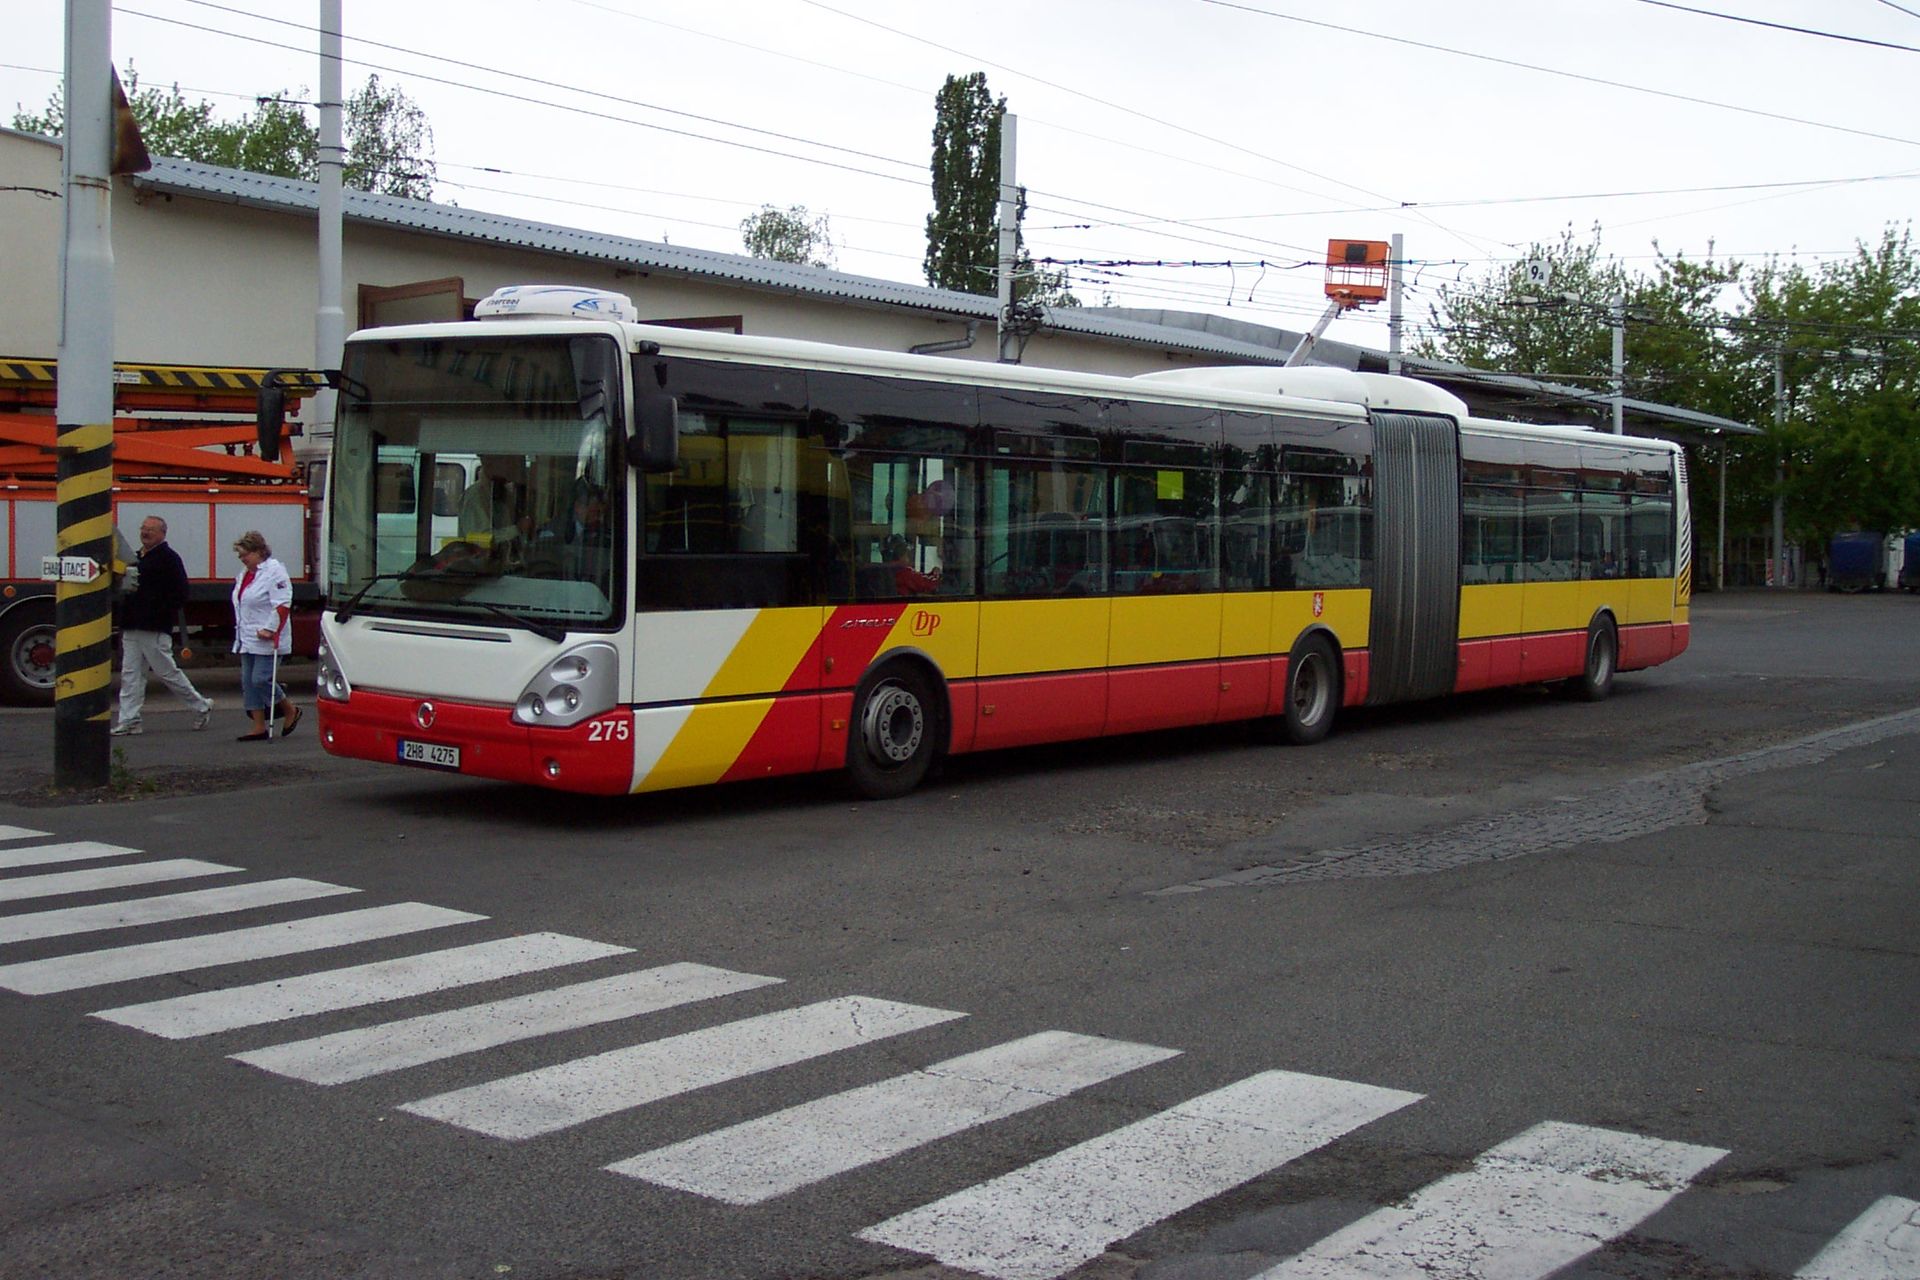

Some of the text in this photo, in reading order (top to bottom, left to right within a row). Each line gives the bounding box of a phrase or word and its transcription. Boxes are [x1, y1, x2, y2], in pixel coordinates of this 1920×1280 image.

[1531, 265, 1544, 280] 9a
[588, 720, 629, 741] 275
[406, 743, 455, 764] 2H8 4275
